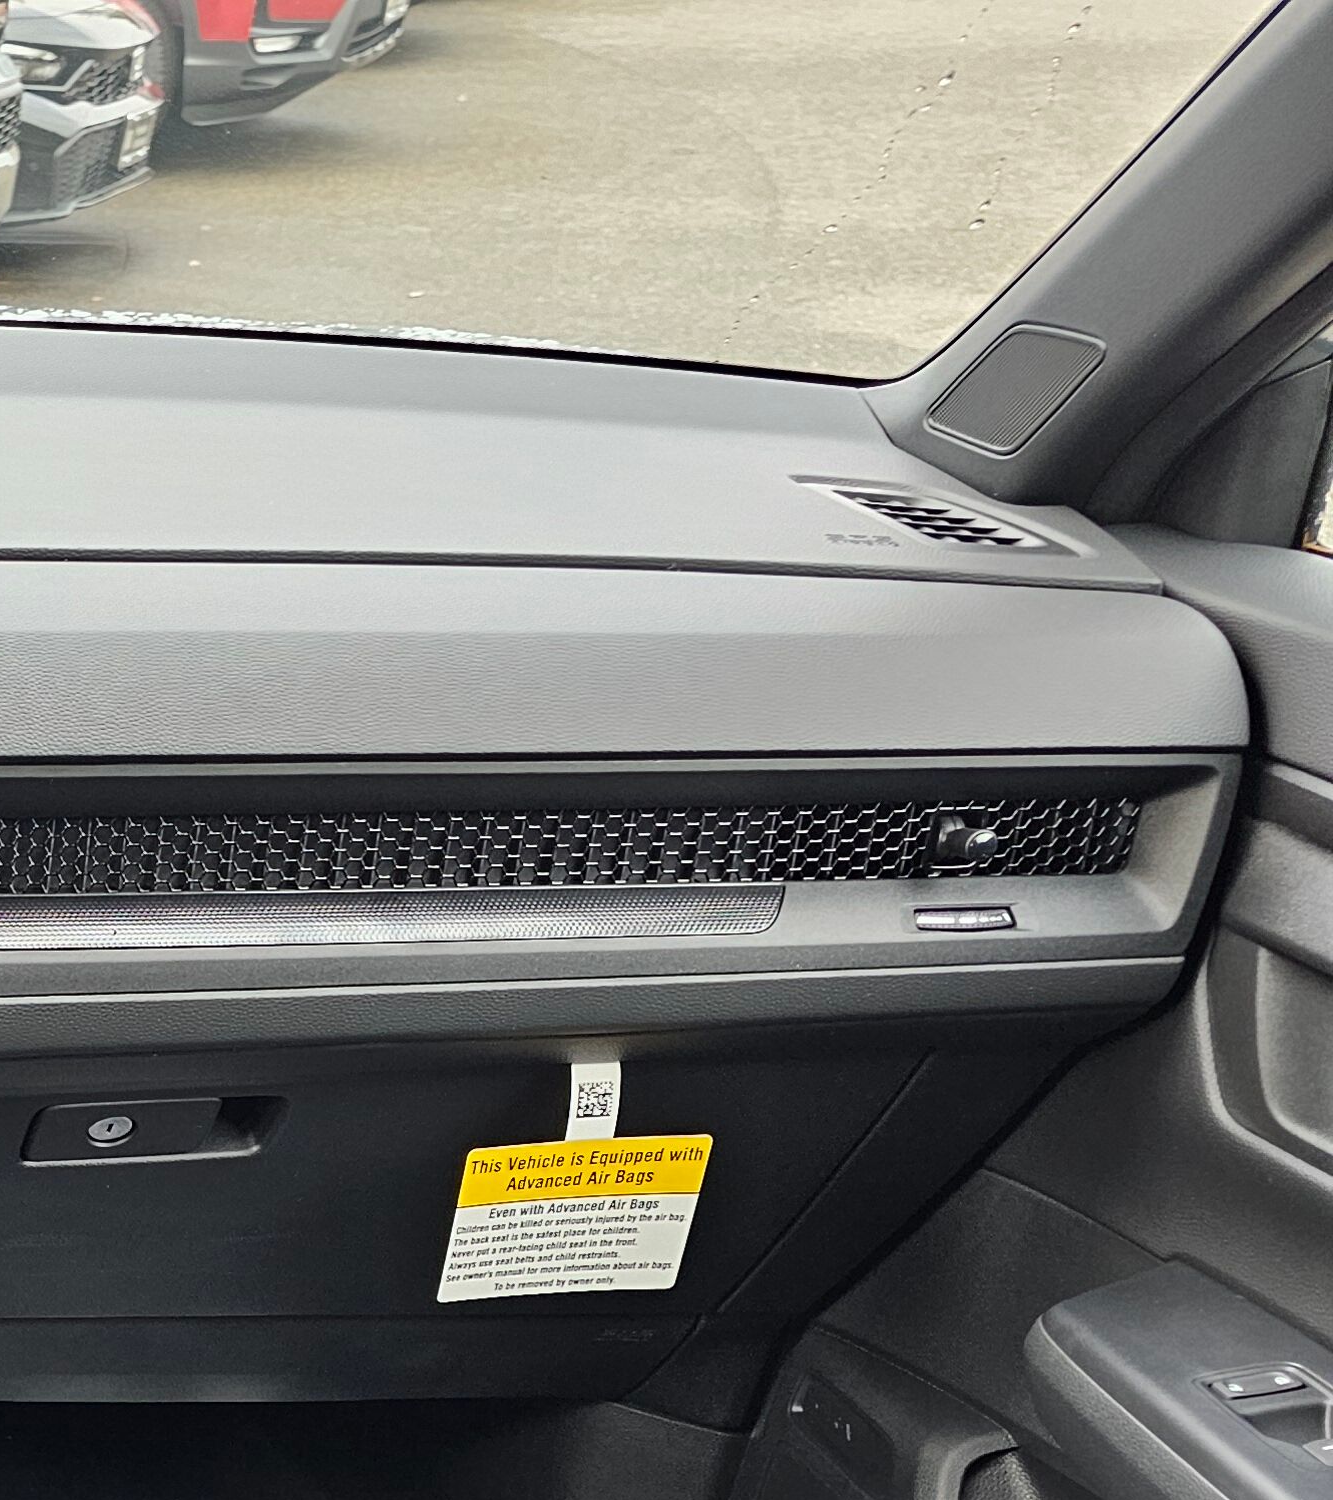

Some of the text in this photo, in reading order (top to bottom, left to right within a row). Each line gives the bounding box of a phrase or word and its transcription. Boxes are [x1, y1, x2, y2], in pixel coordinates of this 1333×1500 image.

[471, 1147, 703, 1174] This Vehicle is Equipped with
[506, 1169, 654, 1191] Advanced Air Bags
[488, 1199, 660, 1219] Even with Advanced Air Bags
[456, 1225, 489, 1235] Children
[491, 1223, 506, 1231] can
[508, 1221, 518, 1229] be
[520, 1219, 543, 1228] killed
[555, 1216, 593, 1226] seriously
[595, 1215, 625, 1225] injured
[627, 1214, 637, 1224] by
[639, 1213, 652, 1222] the
[451, 1250, 474, 1259] Never
[477, 1247, 490, 1257] put
[546, 1240, 566, 1250] child
[569, 1241, 587, 1249] seat
[600, 1238, 613, 1247] the
[454, 1238, 468, 1247] The
[471, 1236, 489, 1245] back
[491, 1234, 509, 1243] seat
[520, 1232, 533, 1240] the
[535, 1230, 561, 1239] safest
[563, 1229, 586, 1239] place
[448, 1260, 476, 1271] Always
[495, 1257, 513, 1266] seat
[537, 1254, 553, 1262] and
[555, 1252, 575, 1260] child
[446, 1274, 460, 1283] See
[495, 1267, 525, 1277] manual
[540, 1266, 561, 1274] more
[563, 1263, 610, 1273] information
[613, 1262, 636, 1270] about
[517, 1279, 554, 1289] removed
